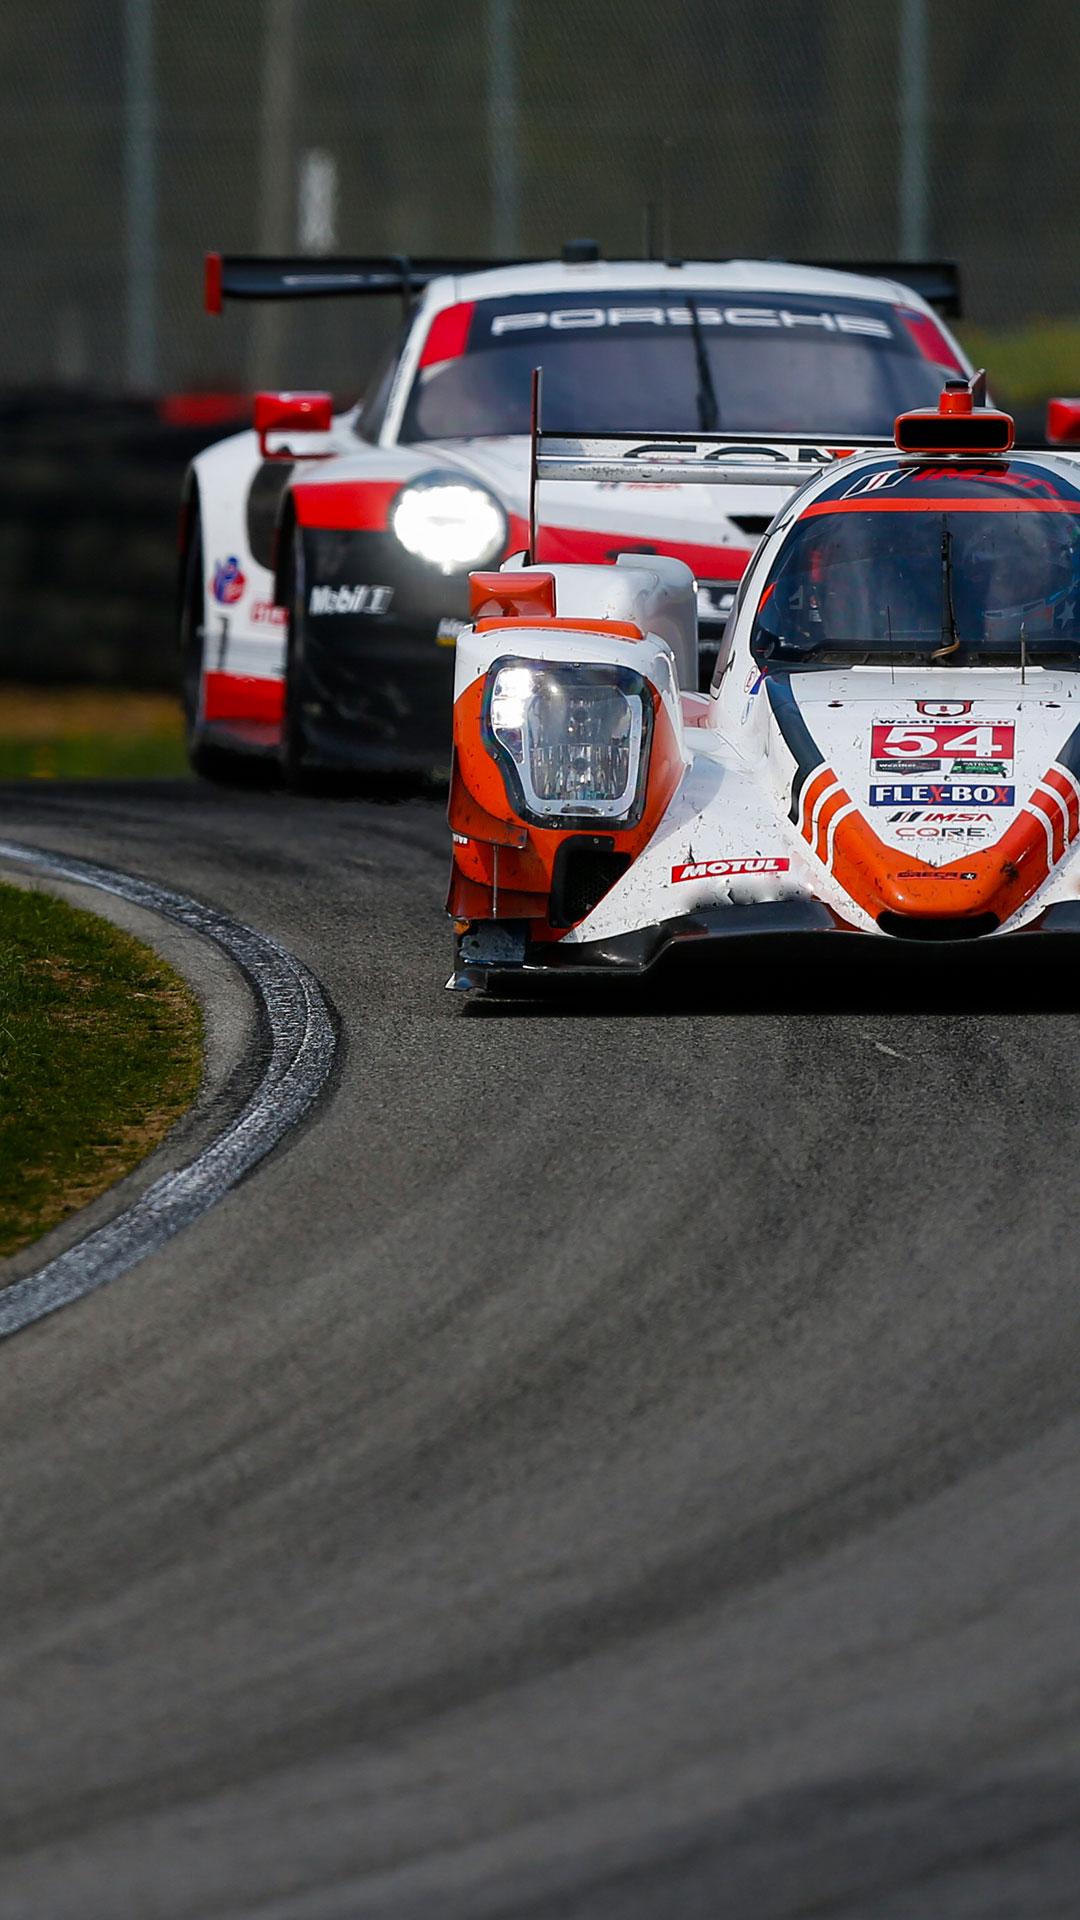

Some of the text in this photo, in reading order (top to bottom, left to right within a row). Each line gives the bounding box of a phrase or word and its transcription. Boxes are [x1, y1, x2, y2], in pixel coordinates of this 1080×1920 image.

[491, 306, 893, 339] PORSCHE
[912, 467, 1060, 497] IMSA
[882, 726, 1003, 758] 54
[875, 786, 1009, 804] FLEX-BOX
[922, 812, 993, 822] IMSA
[680, 859, 780, 880] MOTUL
